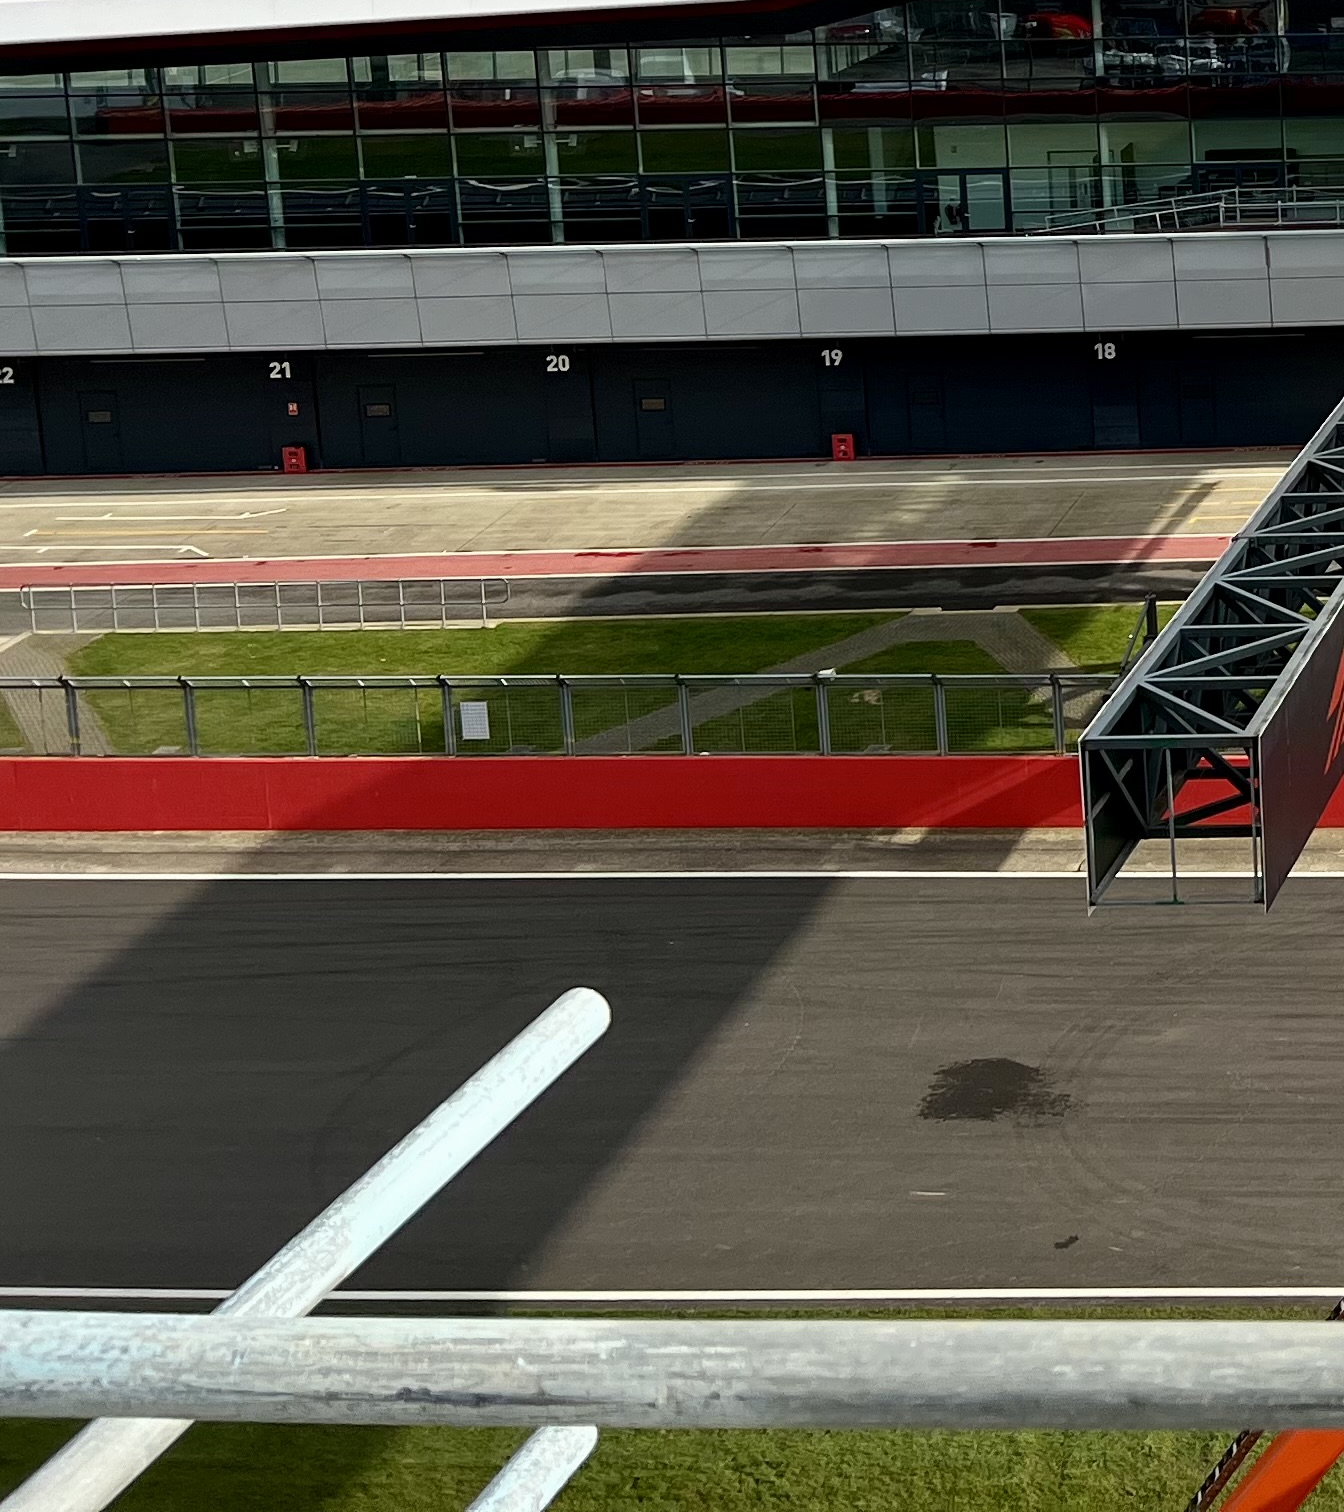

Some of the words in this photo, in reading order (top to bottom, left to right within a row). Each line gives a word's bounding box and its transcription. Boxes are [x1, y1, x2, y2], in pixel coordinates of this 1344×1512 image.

[821, 349, 843, 366] 19
[1094, 343, 1116, 359] 18
[269, 362, 291, 378] 21
[546, 355, 569, 372] 20
[0, 367, 14, 384] 2
